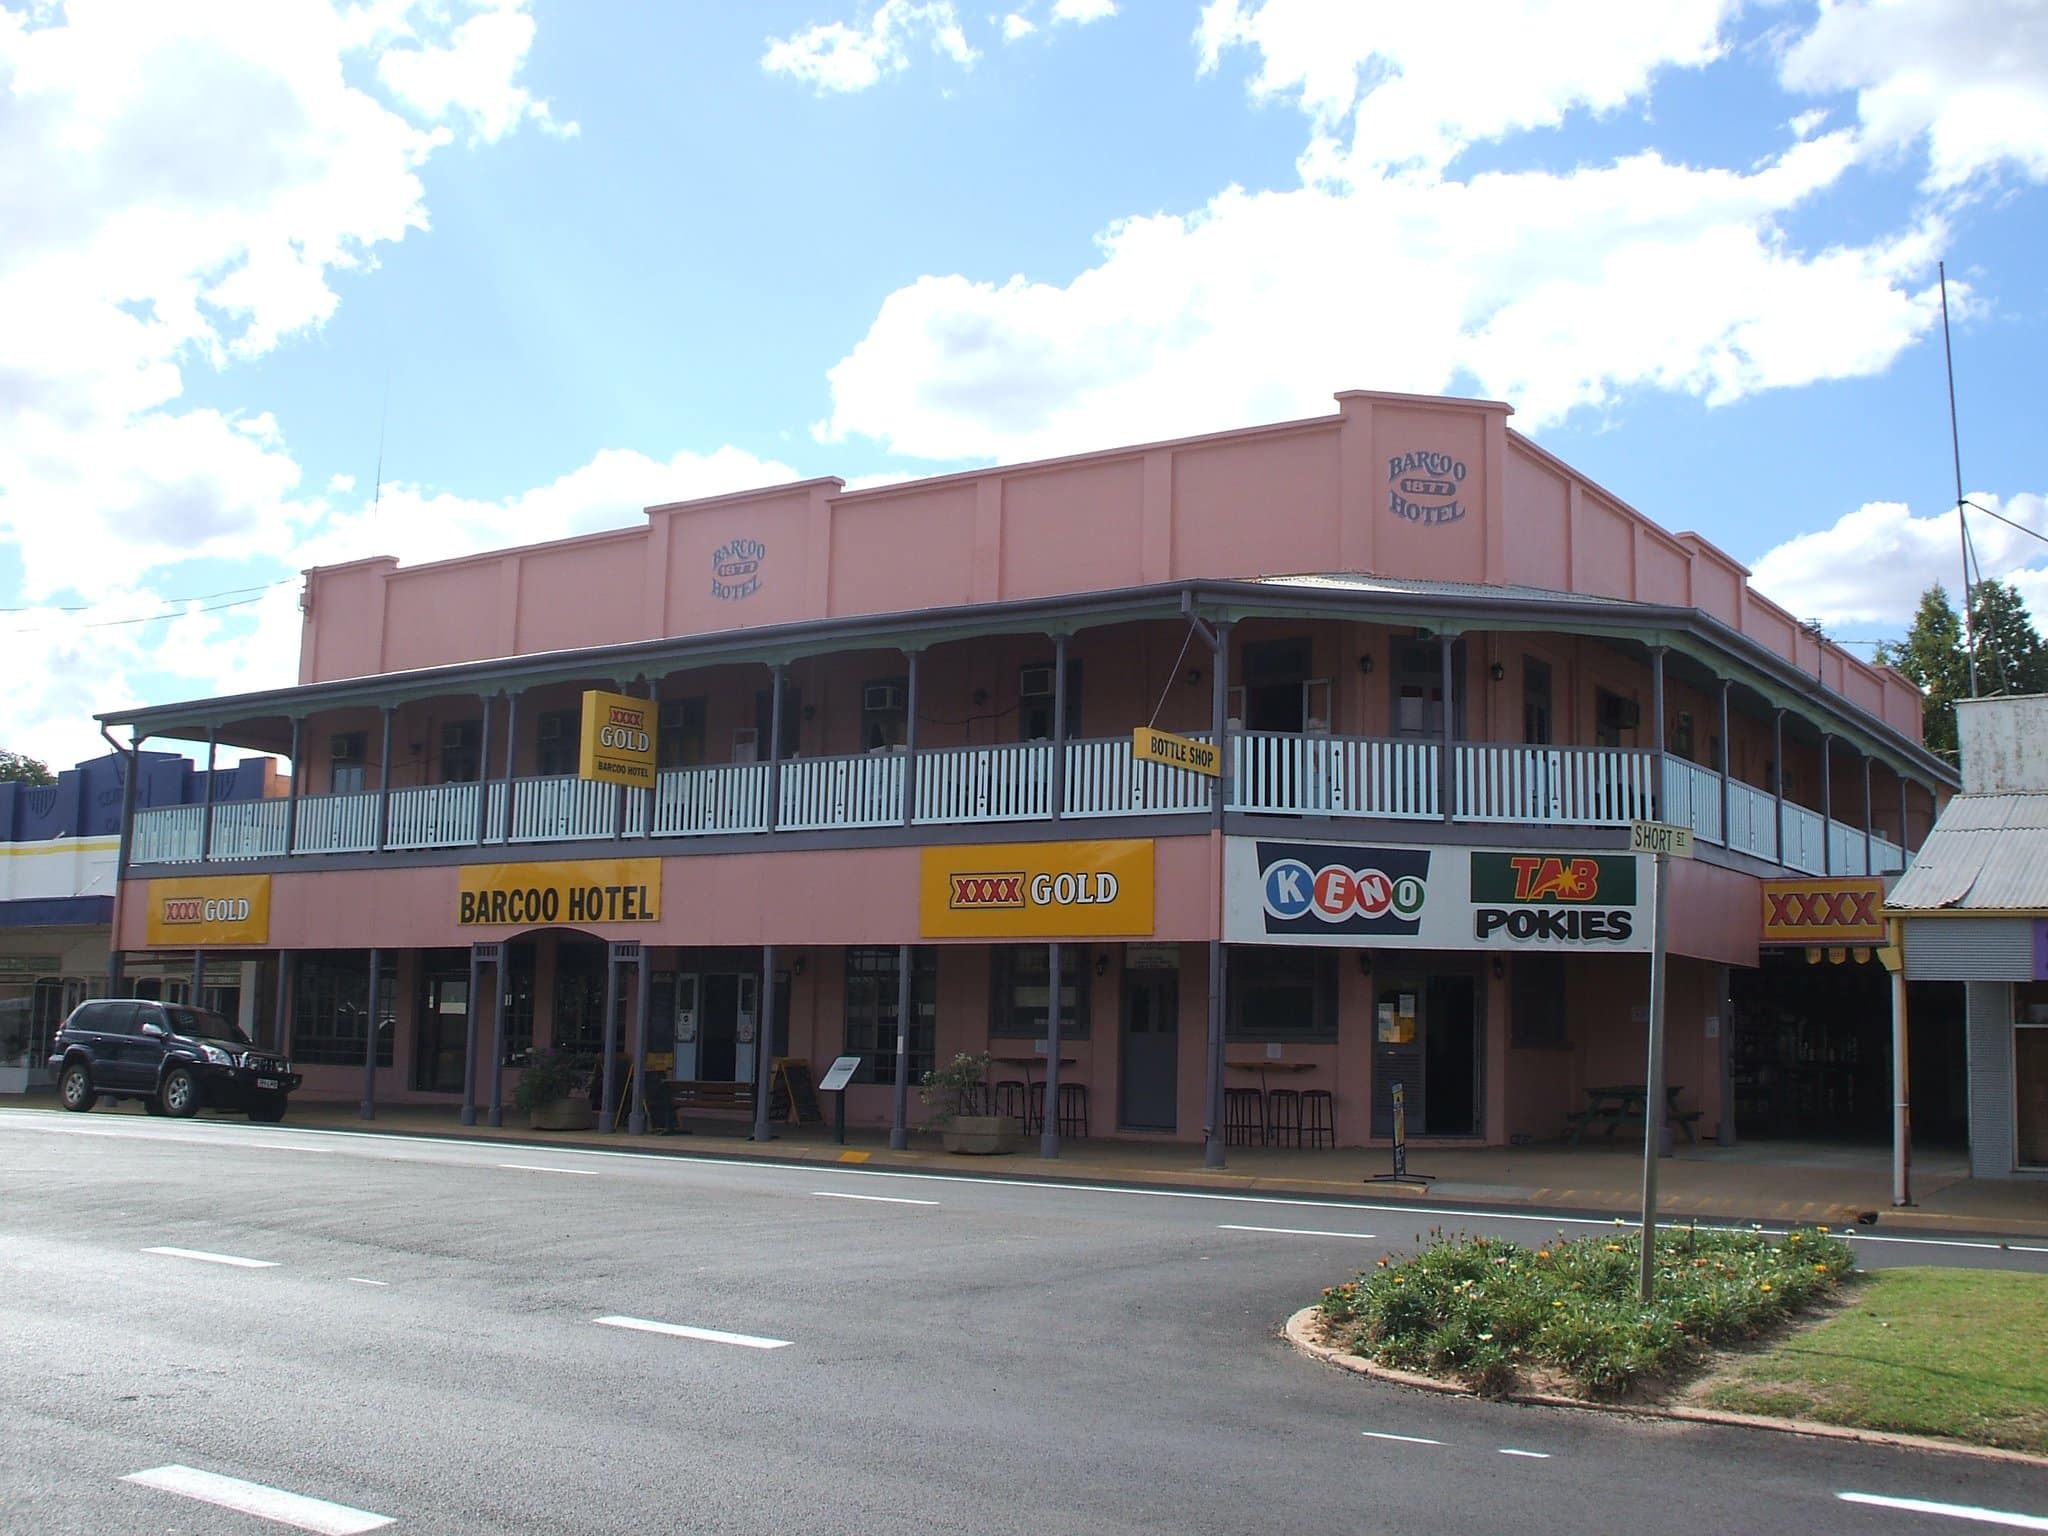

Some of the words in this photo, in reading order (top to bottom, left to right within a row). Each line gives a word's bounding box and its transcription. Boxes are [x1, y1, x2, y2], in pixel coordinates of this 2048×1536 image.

[1389, 451, 1466, 481] BARCOO
[1389, 490, 1466, 525] HOTEL
[712, 539, 766, 569] BARCOO
[712, 576, 762, 600] HOTEL
[611, 709, 642, 726] XXXX
[600, 725, 650, 752] GOLD
[1151, 736, 1186, 762] BOTTLE
[1189, 746, 1213, 768] SHOP
[598, 761, 626, 774] BARCOO
[628, 766, 649, 777] HOTEL
[1635, 825, 1672, 851] SHORT
[1676, 831, 1685, 846] ST
[955, 877, 1021, 903] XXXX
[1030, 873, 1119, 905] GOLD
[1277, 869, 1417, 909] KENO
[1511, 857, 1599, 901] TAB
[166, 902, 200, 920] XXXX
[204, 898, 249, 921] GOLD
[460, 887, 559, 923] BARCOO
[569, 885, 653, 921] HOTEL
[1767, 892, 1878, 926] XXXX
[1475, 909, 1633, 943] POKIES
